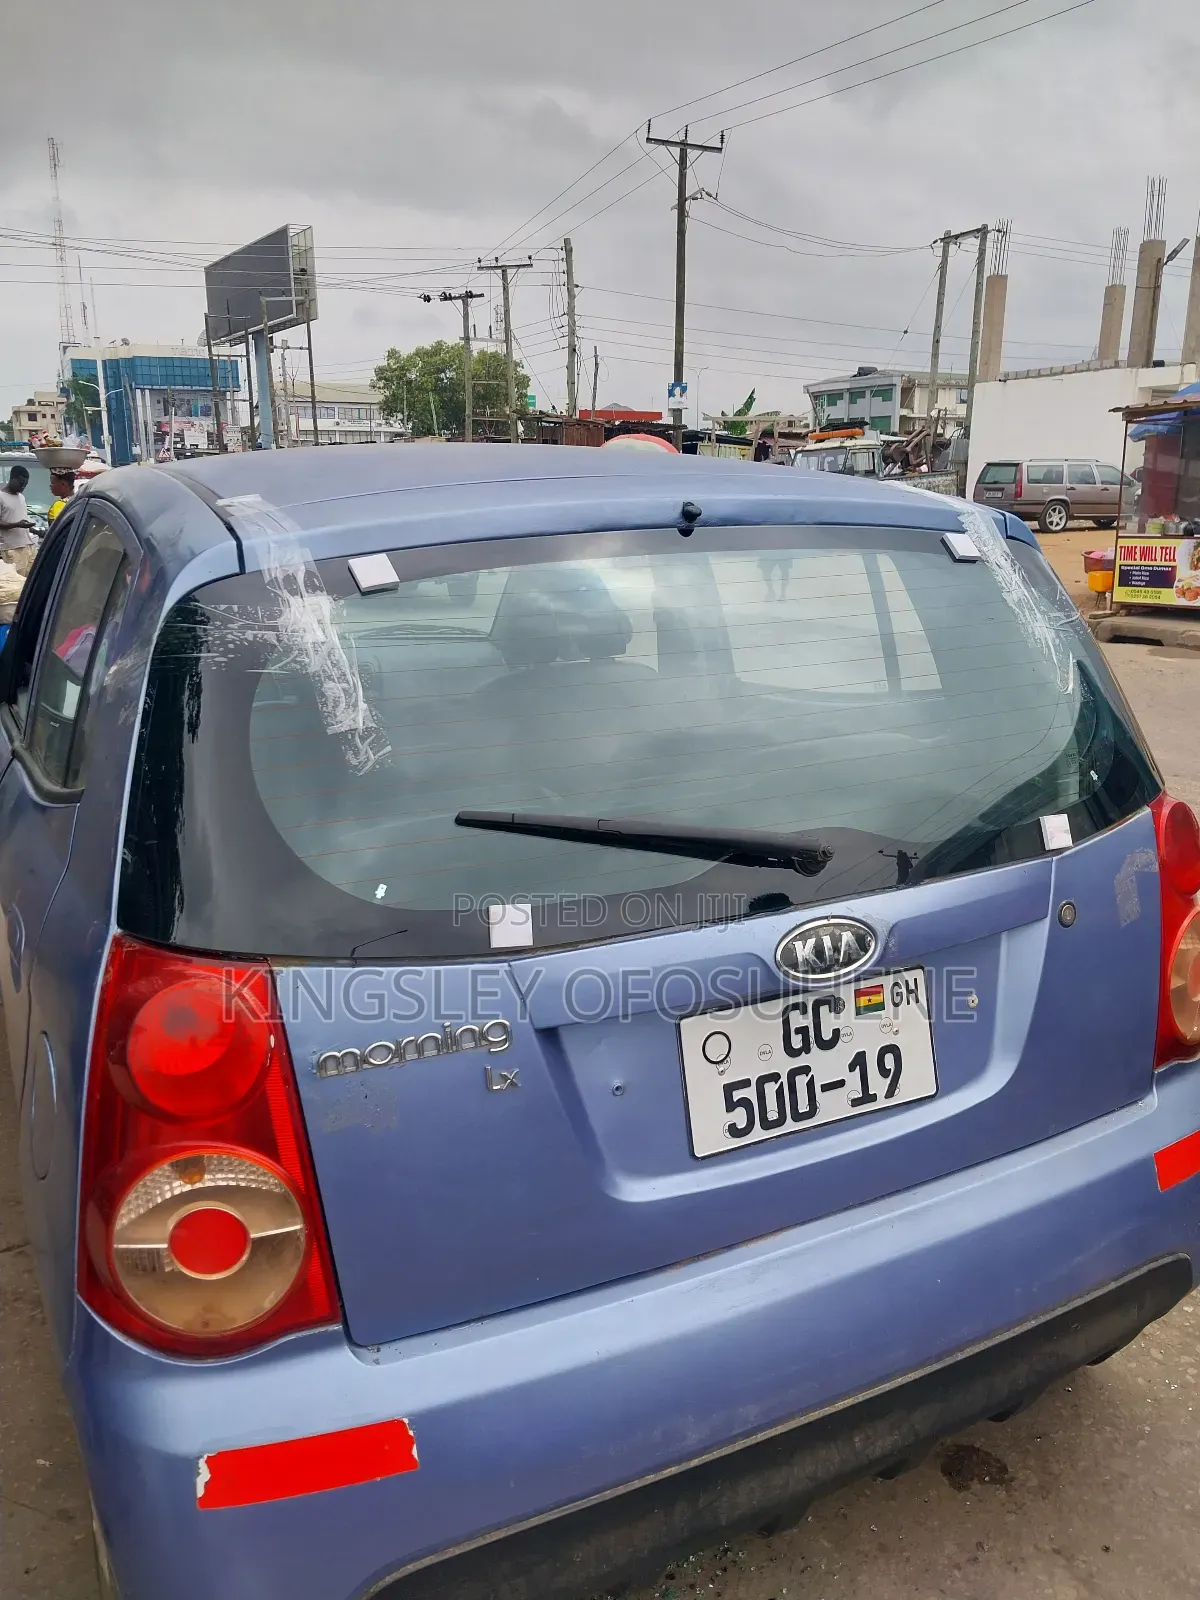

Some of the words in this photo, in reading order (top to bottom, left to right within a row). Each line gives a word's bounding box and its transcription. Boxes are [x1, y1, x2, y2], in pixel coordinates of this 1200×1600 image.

[1119, 545, 1138, 561] TIME
[1140, 545, 1158, 562] WILL
[1160, 546, 1176, 562] TELL
[793, 931, 865, 971] KIA
[782, 994, 841, 1058] GC
[890, 977, 920, 1008] GH
[317, 1019, 513, 1078] morning
[722, 1043, 903, 1138] 500-19
